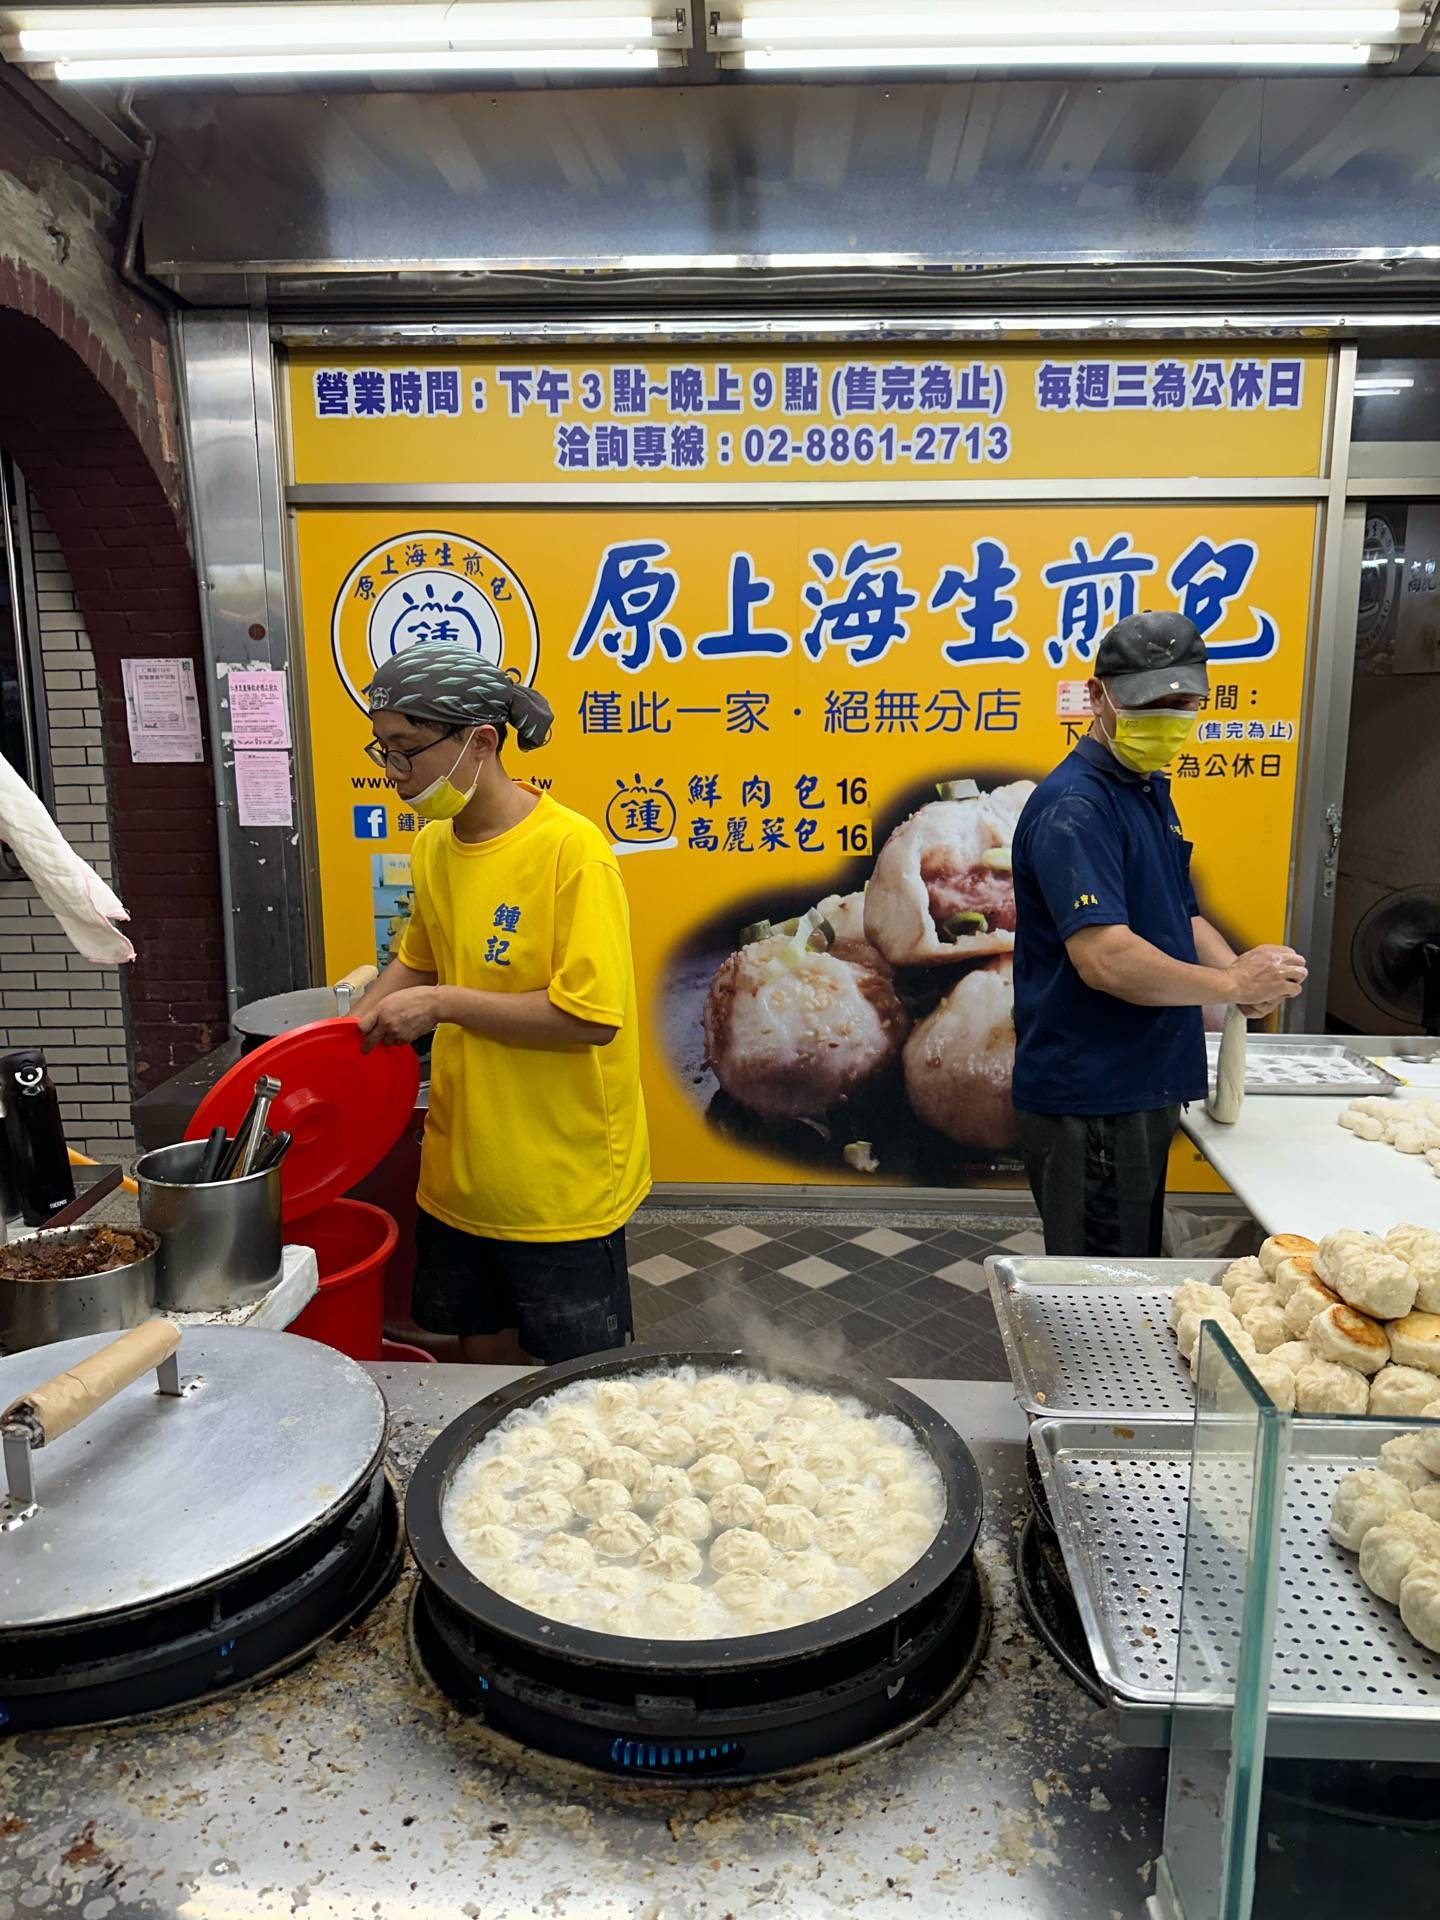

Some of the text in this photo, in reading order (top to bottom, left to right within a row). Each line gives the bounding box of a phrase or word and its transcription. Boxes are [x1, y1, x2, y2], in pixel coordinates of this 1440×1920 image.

[1037, 361, 1302, 409] 每週三為公休日
[354, 542, 512, 601] 原上海生煎包
[570, 533, 1276, 671] 原上海生煎包
[1198, 721, 1293, 741] (售完為止)
[1163, 753, 1280, 778] 為公休日
[688, 773, 867, 809] 鮮肉包 16
[688, 816, 868, 853] 高麗菜包 16
